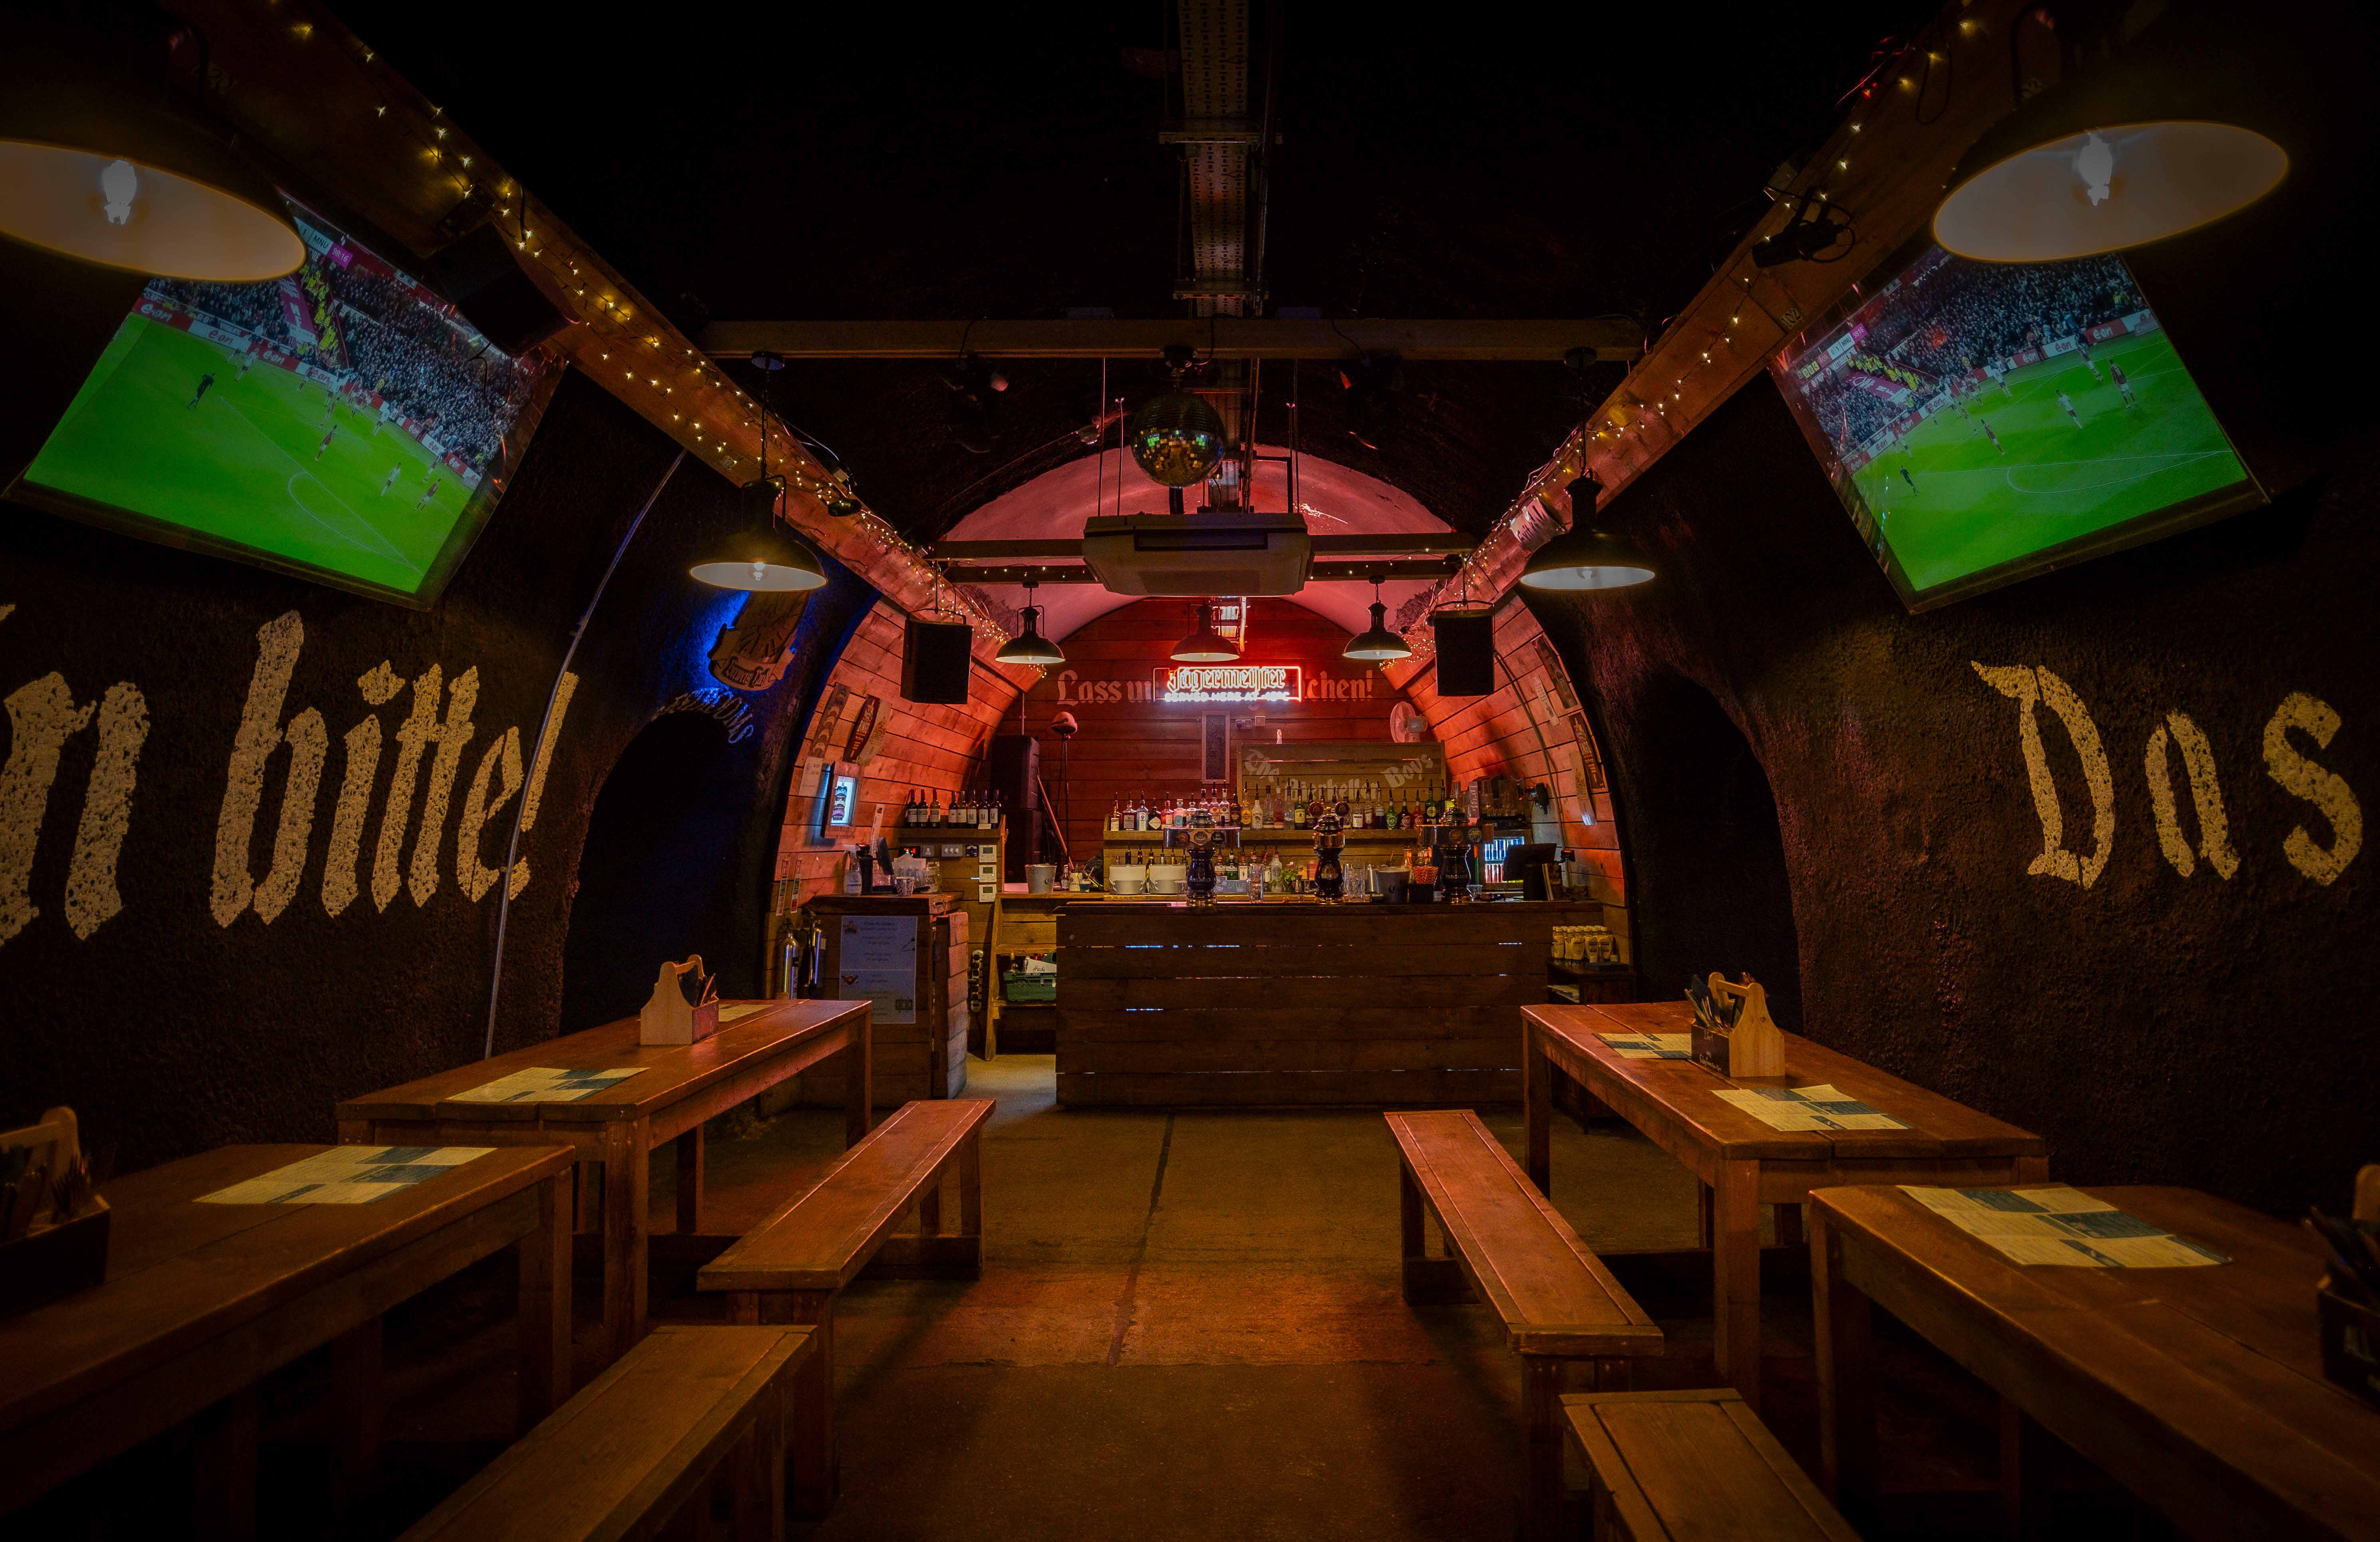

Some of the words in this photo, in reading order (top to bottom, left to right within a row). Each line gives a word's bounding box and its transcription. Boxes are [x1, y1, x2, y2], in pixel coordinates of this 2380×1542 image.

[313, 236, 329, 249] MNU
[332, 248, 349, 262] 98:16
[1841, 337, 1851, 346] MNU
[1057, 670, 1122, 706] Lass
[1303, 670, 1373, 702] chen!
[210, 610, 579, 928] bitte!
[1244, 749, 1279, 782] The
[1285, 778, 1379, 802] Bierkeller
[1380, 754, 1433, 788] Boys
[1971, 660, 2363, 889] Das
